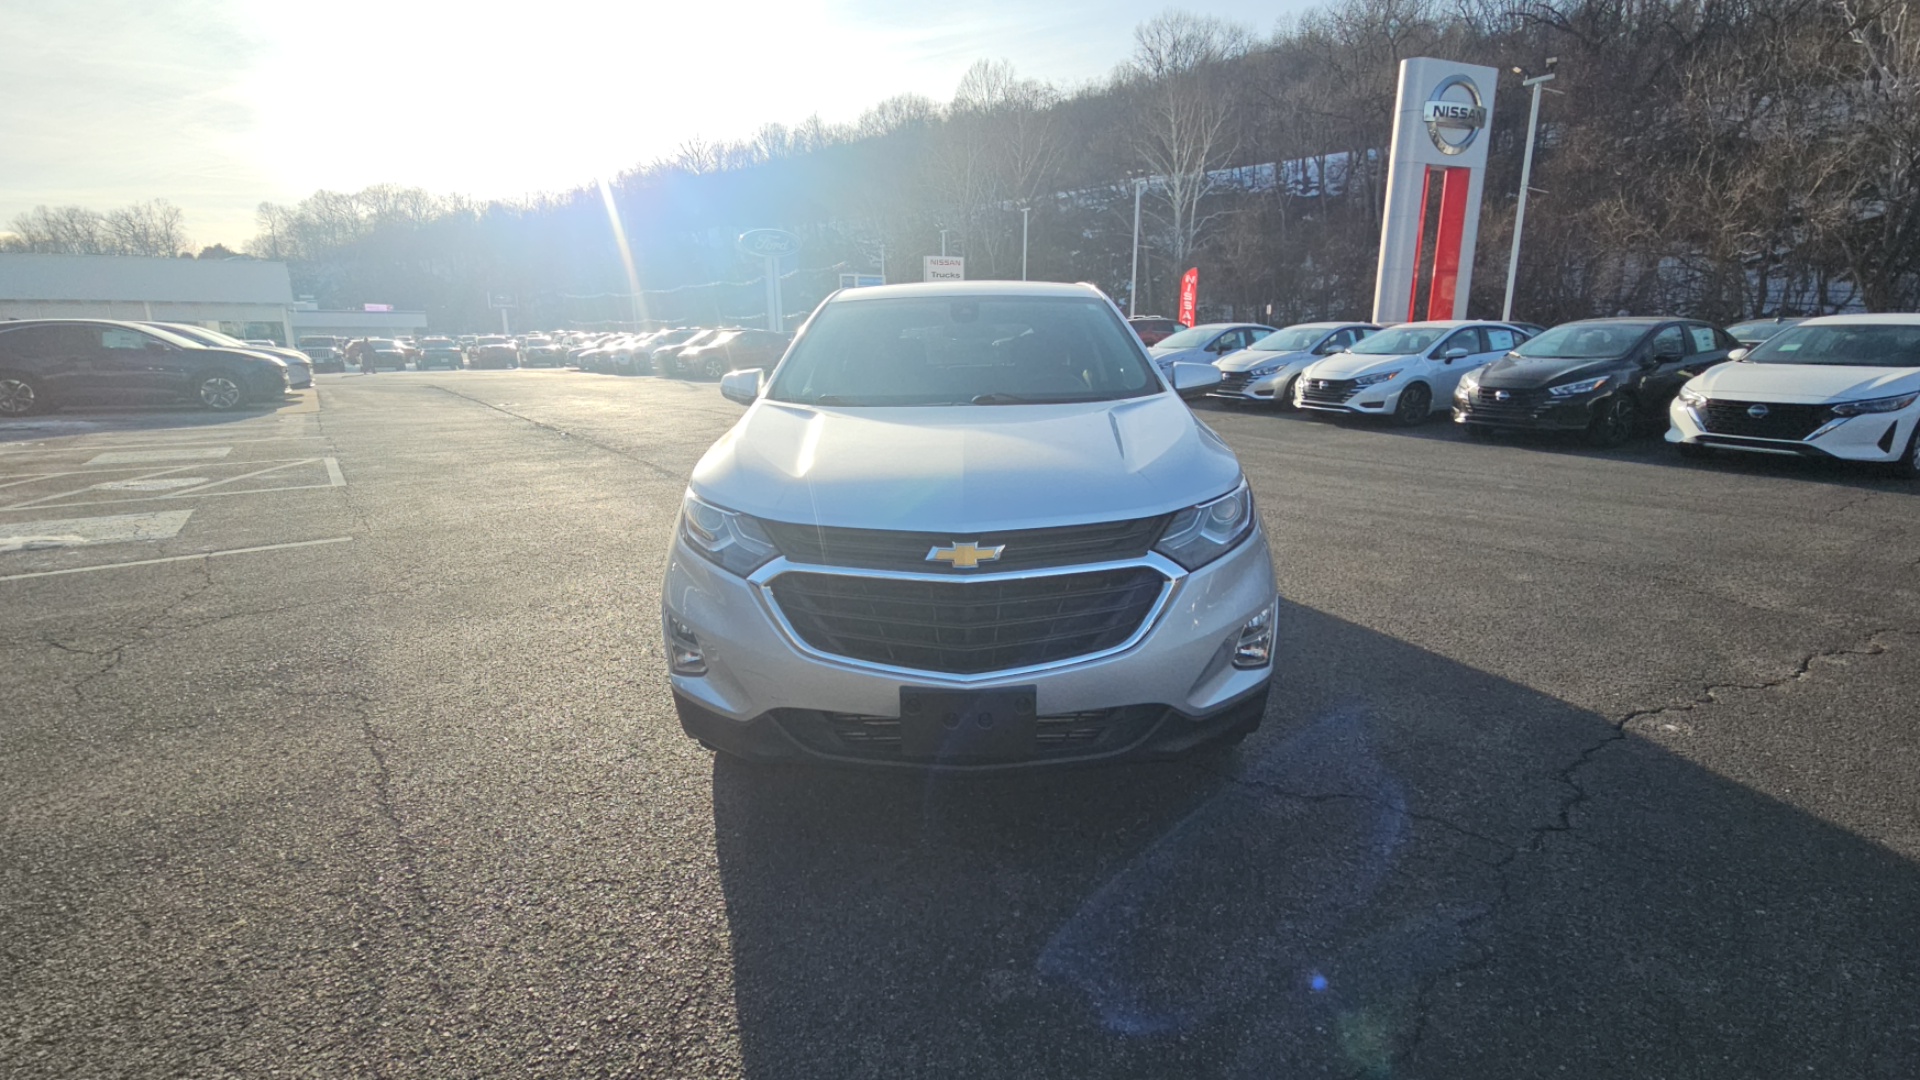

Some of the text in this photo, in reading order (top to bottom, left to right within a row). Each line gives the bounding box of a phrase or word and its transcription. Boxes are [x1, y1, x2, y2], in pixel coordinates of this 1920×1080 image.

[1433, 105, 1482, 122] NISSAN
[754, 234, 790, 250] Ford
[931, 271, 961, 279] Trucks
